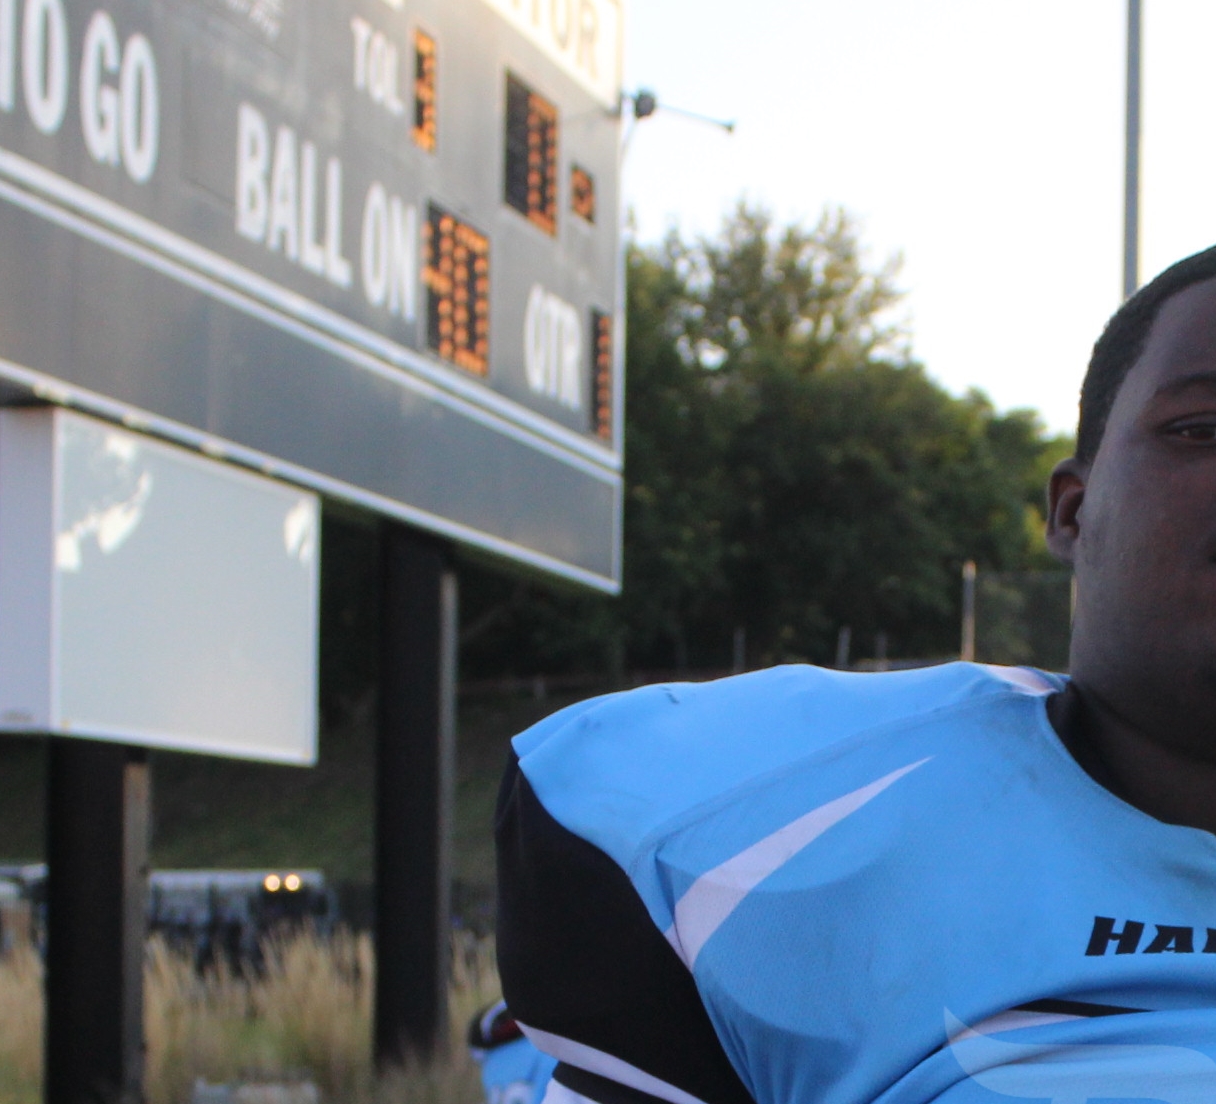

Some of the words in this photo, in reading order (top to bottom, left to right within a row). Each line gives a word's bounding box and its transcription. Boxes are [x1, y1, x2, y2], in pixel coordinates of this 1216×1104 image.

[79, 9, 160, 184] GO
[235, 102, 353, 290] BALL
[362, 180, 416, 324] ON
